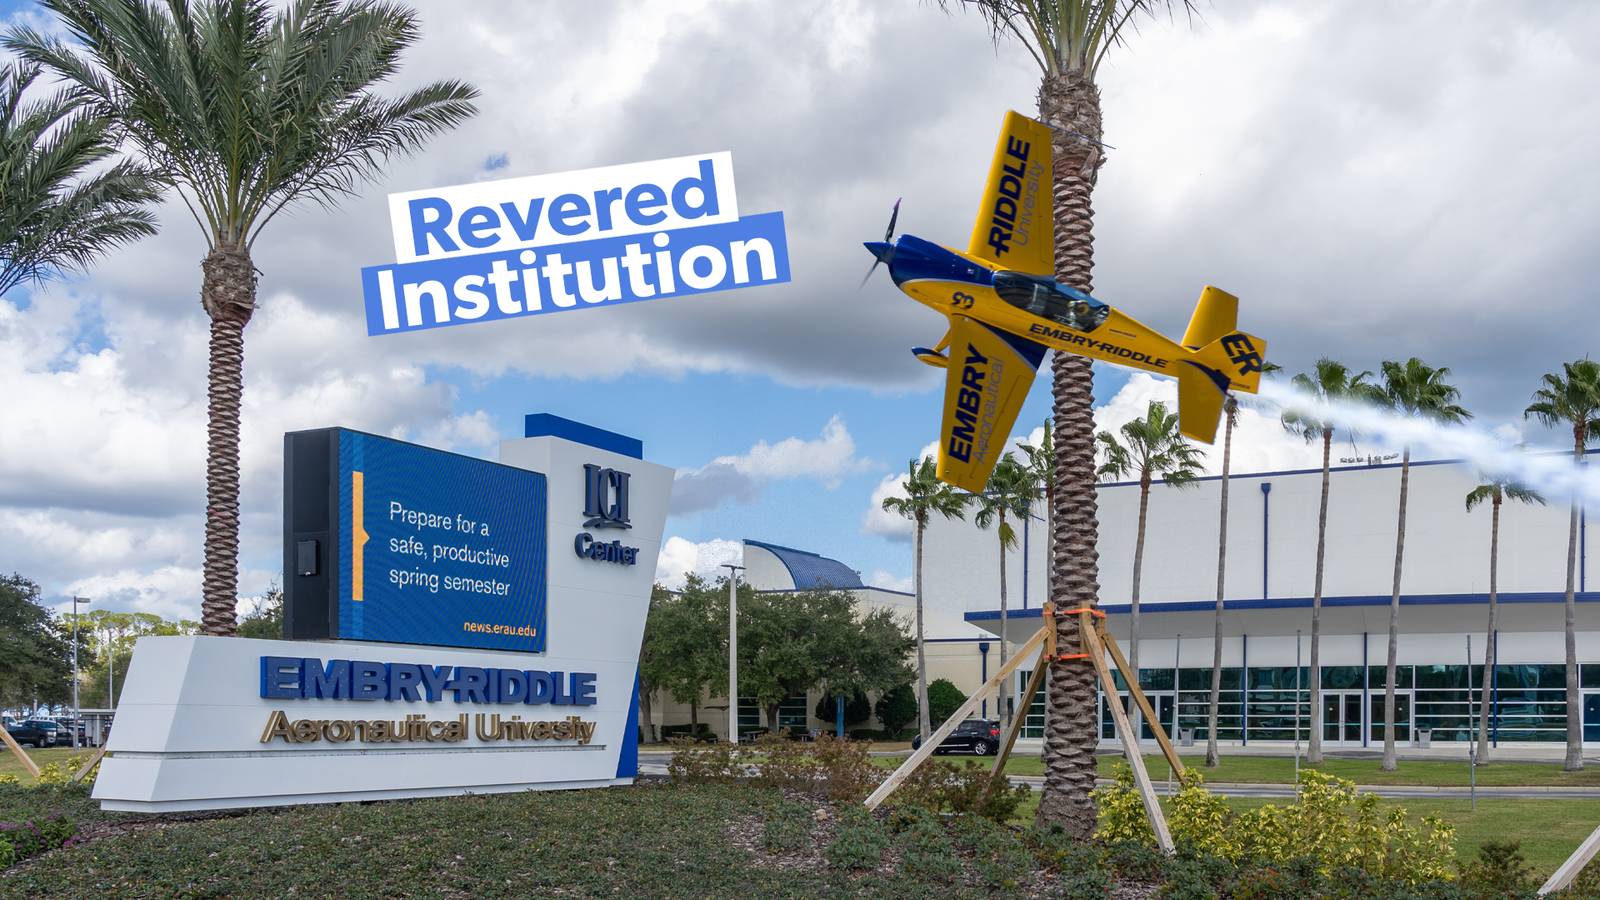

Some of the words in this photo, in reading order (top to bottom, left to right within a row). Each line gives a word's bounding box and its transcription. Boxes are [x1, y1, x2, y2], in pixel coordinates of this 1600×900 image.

[1011, 159, 1045, 247] University
[1029, 322, 1168, 369] EMBRY-RIDDLE
[948, 342, 989, 464] EMBRY
[972, 356, 1005, 465] Aeronautical
[389, 501, 452, 531] Prepare
[456, 513, 476, 534] for
[480, 522, 490, 537] a
[389, 535, 428, 561] safe,
[432, 544, 510, 568] productive
[574, 532, 640, 566] Center
[389, 566, 439, 594] spring
[443, 575, 511, 597] semester
[463, 621, 537, 638] news.erau.edu
[260, 655, 598, 706] EMBRY-RIDDLE
[259, 710, 469, 744] Aeronautical
[475, 713, 597, 745] University
